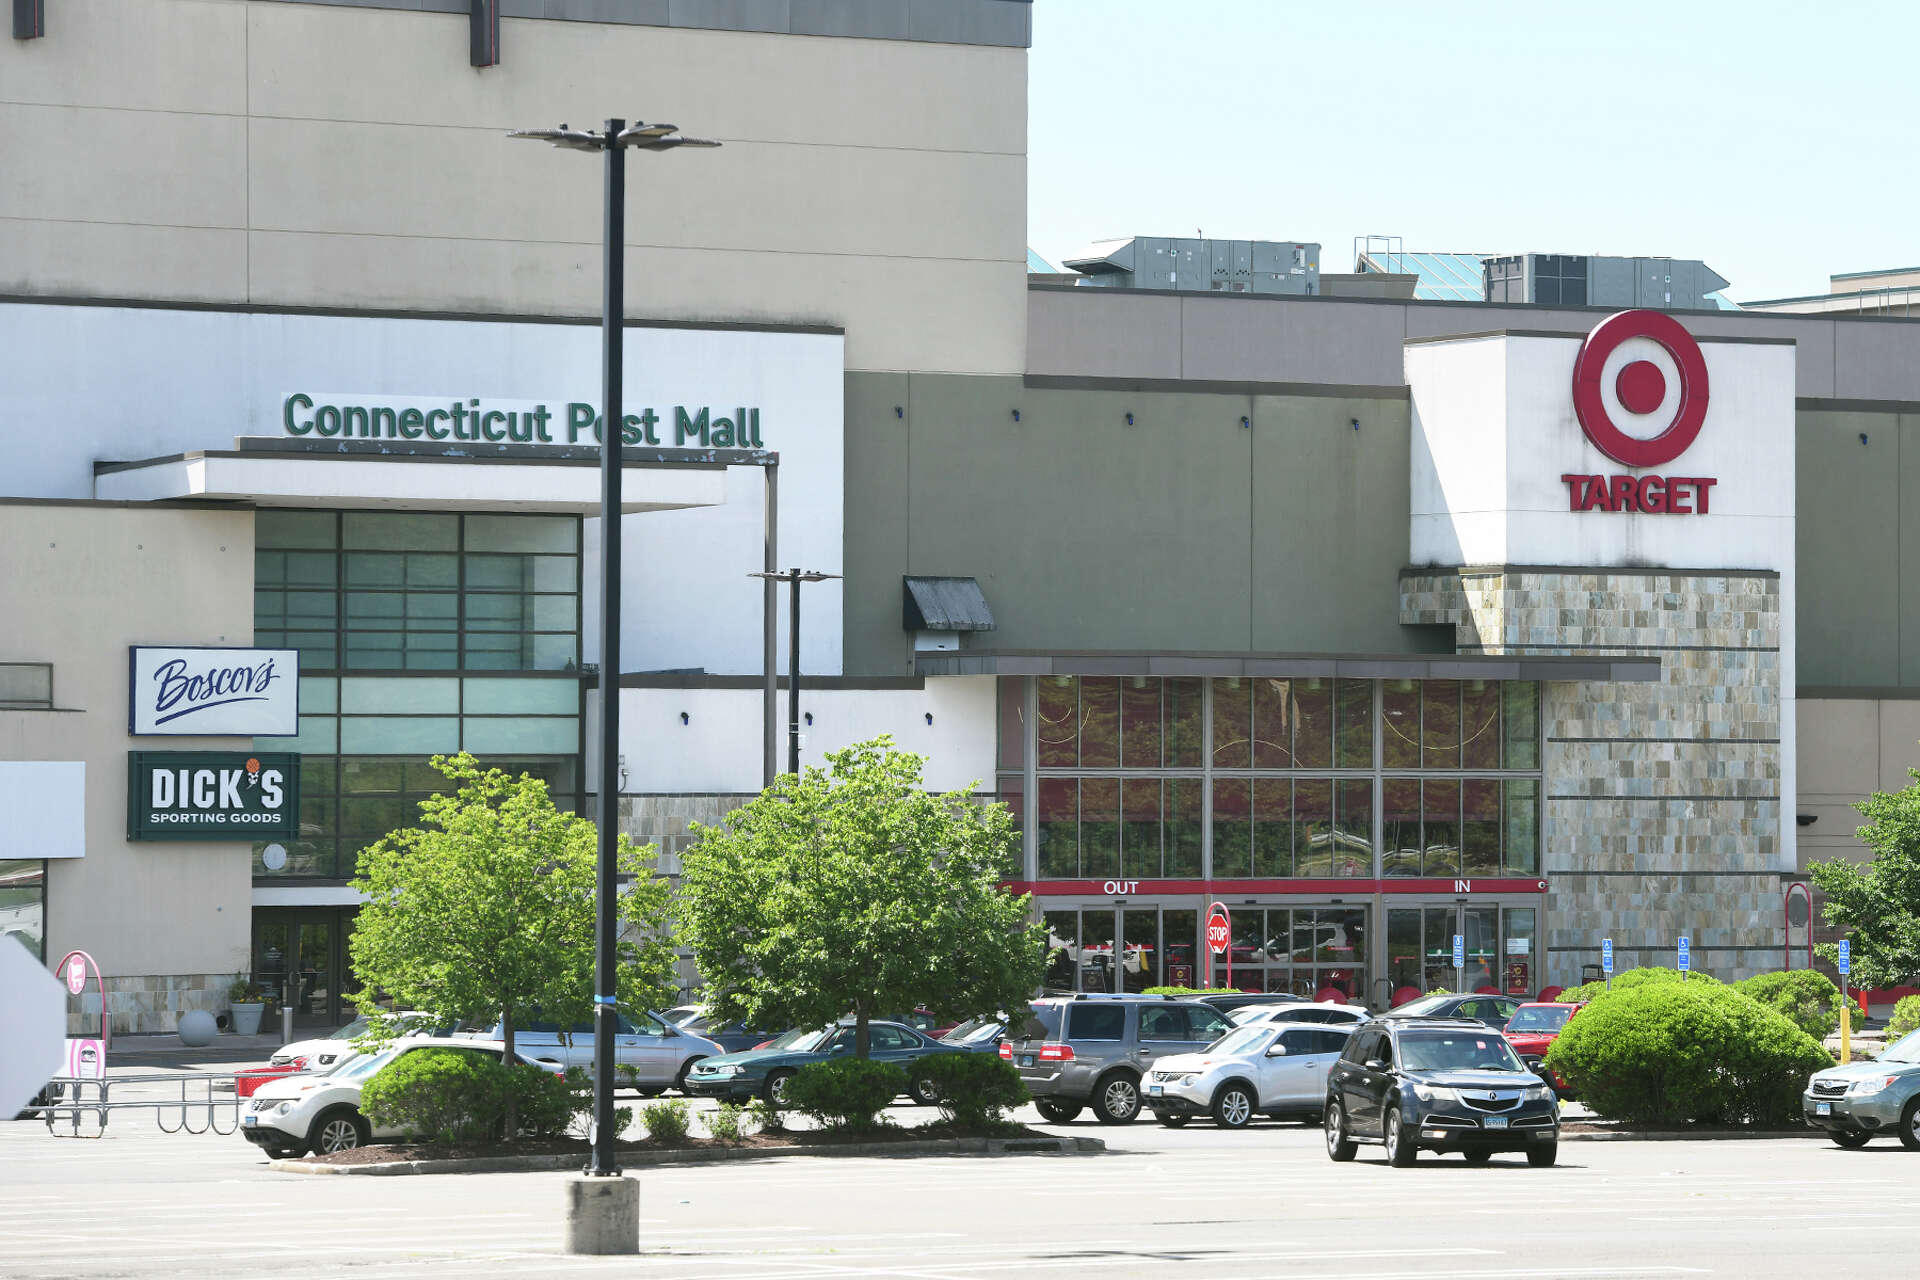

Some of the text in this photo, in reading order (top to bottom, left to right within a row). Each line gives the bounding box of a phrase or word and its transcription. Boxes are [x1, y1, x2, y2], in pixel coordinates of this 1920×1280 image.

[284, 392, 765, 448] Connecticut Pst Mall
[1561, 474, 1718, 515] TARGET
[153, 658, 280, 712] Boscov's
[151, 767, 284, 809] DICK'S
[150, 813, 282, 823] SPORTING GOODS
[1103, 880, 1139, 895] OUT
[1454, 879, 1471, 893] IN
[1208, 926, 1229, 942] STOP
